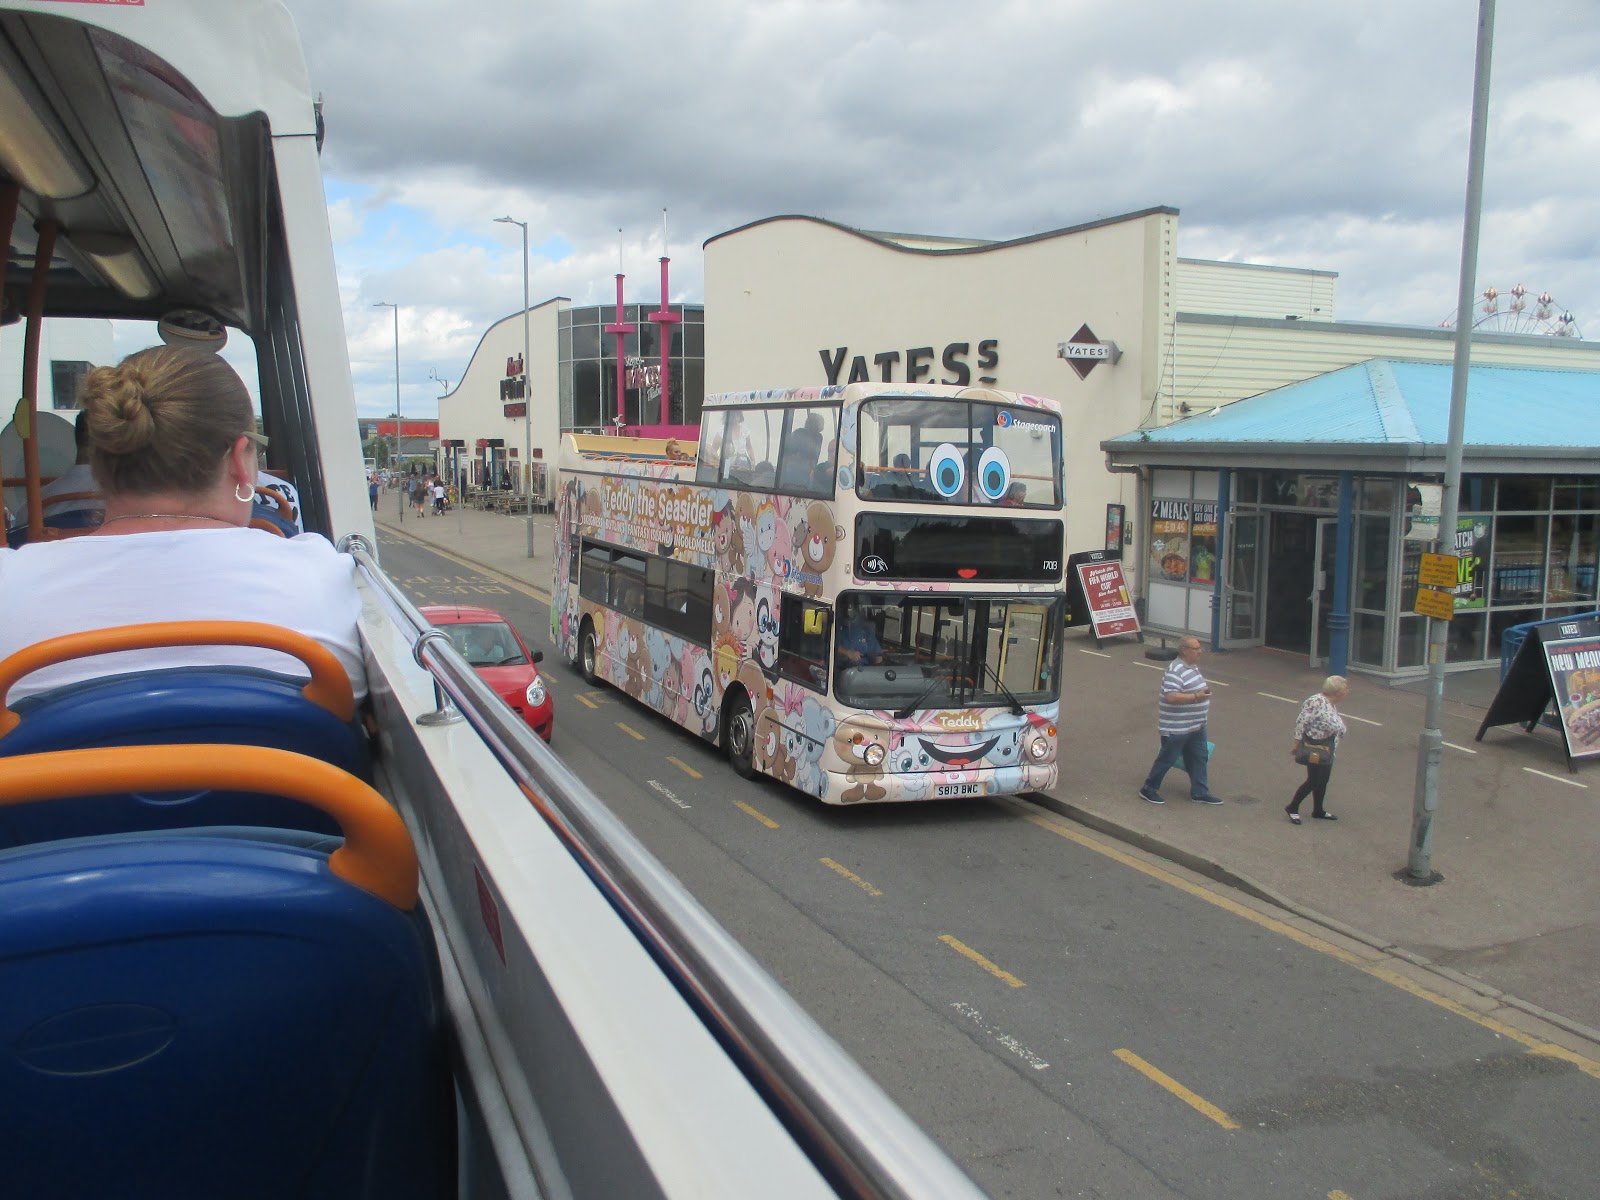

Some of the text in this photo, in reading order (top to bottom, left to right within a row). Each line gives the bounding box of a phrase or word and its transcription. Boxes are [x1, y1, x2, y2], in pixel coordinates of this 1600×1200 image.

[1013, 418, 1056, 433] Stagecoach
[605, 485, 713, 528] Teddy the Seasider
[1152, 500, 1189, 521] 2 MEALS
[627, 524, 650, 541] FANTASY
[650, 528, 672, 545] ISLAND
[673, 533, 716, 555] INGOLDMELLS
[1454, 531, 1473, 549] ATCH
[1100, 571, 1119, 583] WORLD
[940, 715, 980, 730] Teddy
[938, 784, 978, 796] S813 BWC
